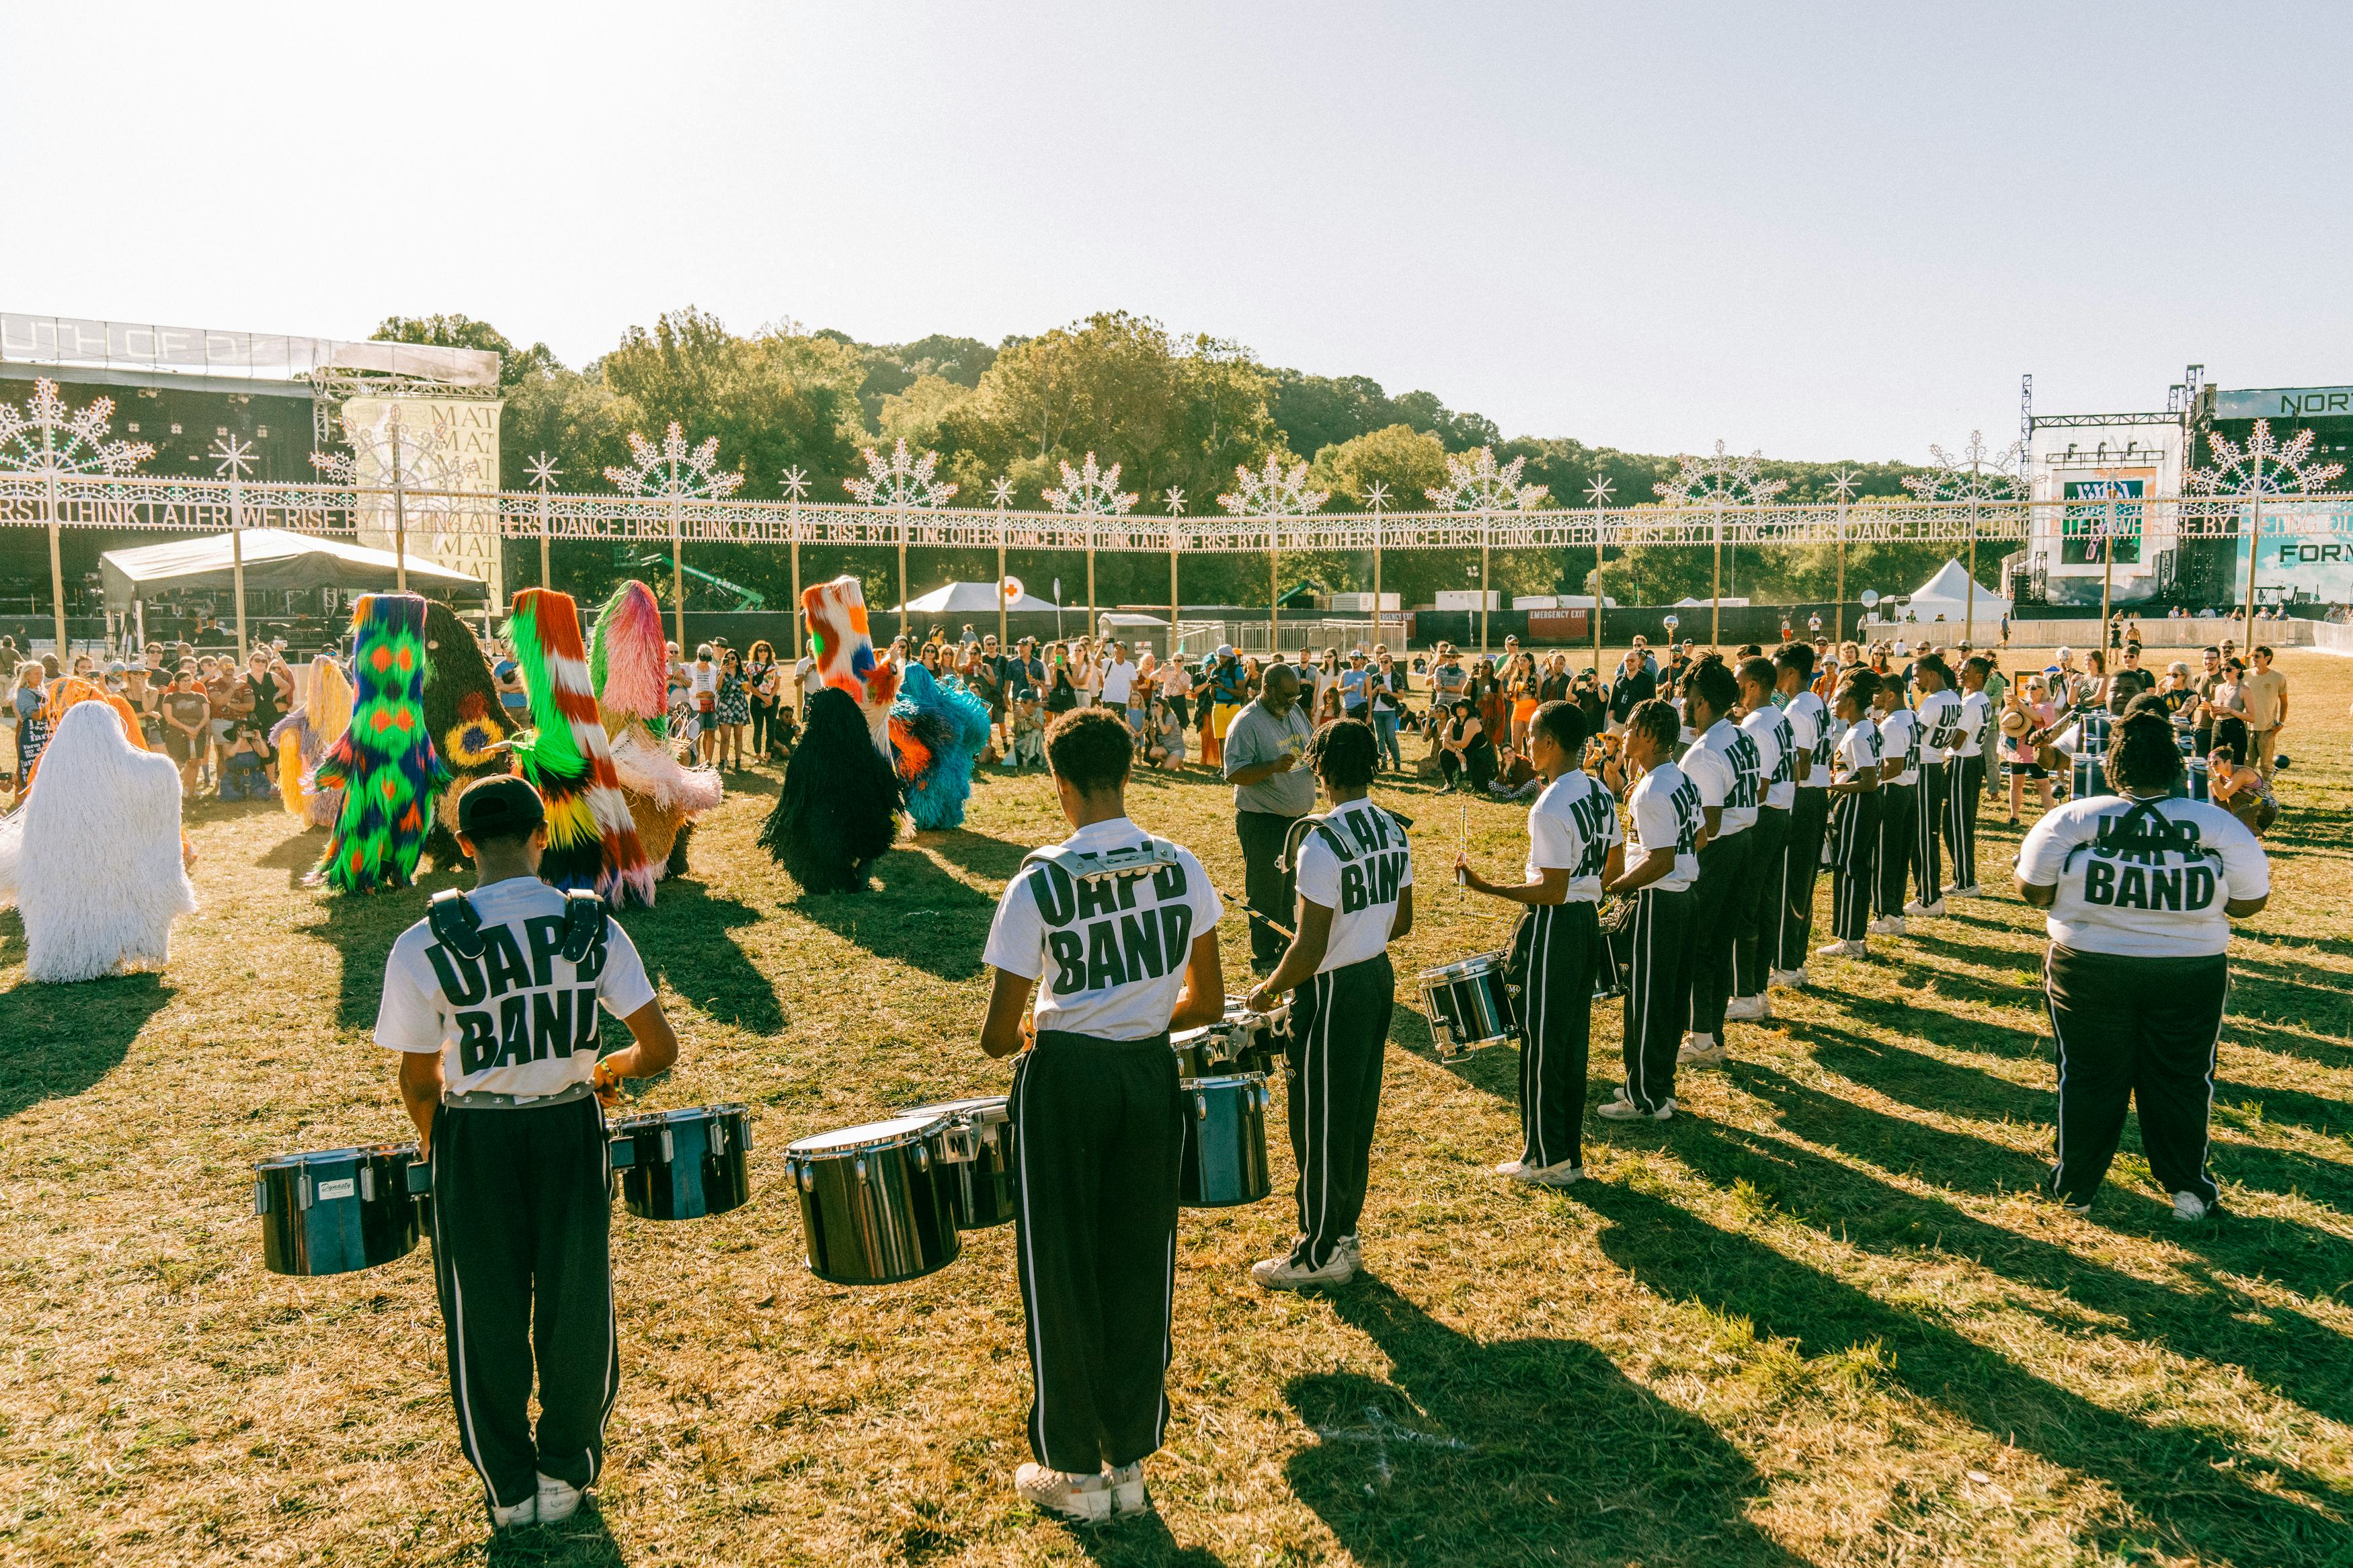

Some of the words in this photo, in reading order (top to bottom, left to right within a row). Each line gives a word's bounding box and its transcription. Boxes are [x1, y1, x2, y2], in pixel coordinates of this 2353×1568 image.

[0, 319, 110, 356] UTH
[2280, 393, 2353, 413] NOR
[0, 499, 46, 522] RST
[65, 501, 141, 525] THINK
[149, 503, 230, 527] LATER
[287, 508, 337, 530] RISE
[383, 510, 461, 533] LFTING
[553, 516, 618, 537] DANCE
[685, 520, 734, 540] THINK
[827, 524, 863, 543] RISE
[1009, 529, 1053, 548] DANCE
[1201, 534, 1234, 549] RISE
[1320, 532, 1376, 548] OTHERS
[1382, 530, 1435, 546] DANCE
[1492, 528, 1542, 546] THINK
[1632, 526, 1669, 544] RISE
[1675, 525, 1699, 544] BY
[1773, 524, 1840, 542] OTHERS
[1849, 522, 1911, 540] DANCE
[2204, 515, 2231, 535] BY
[1371, 612, 1402, 620] EERGENCY
[1402, 612, 1414, 621] EXIT
[1529, 610, 1569, 619] EMERGENCY
[1570, 610, 1586, 618] EXIT
[1938, 704, 1962, 727] UAP
[1341, 852, 1408, 915] BAND
[2084, 860, 2216, 912] BAND
[1048, 904, 1193, 995] BAND
[321, 1182, 351, 1192] Dynasty
